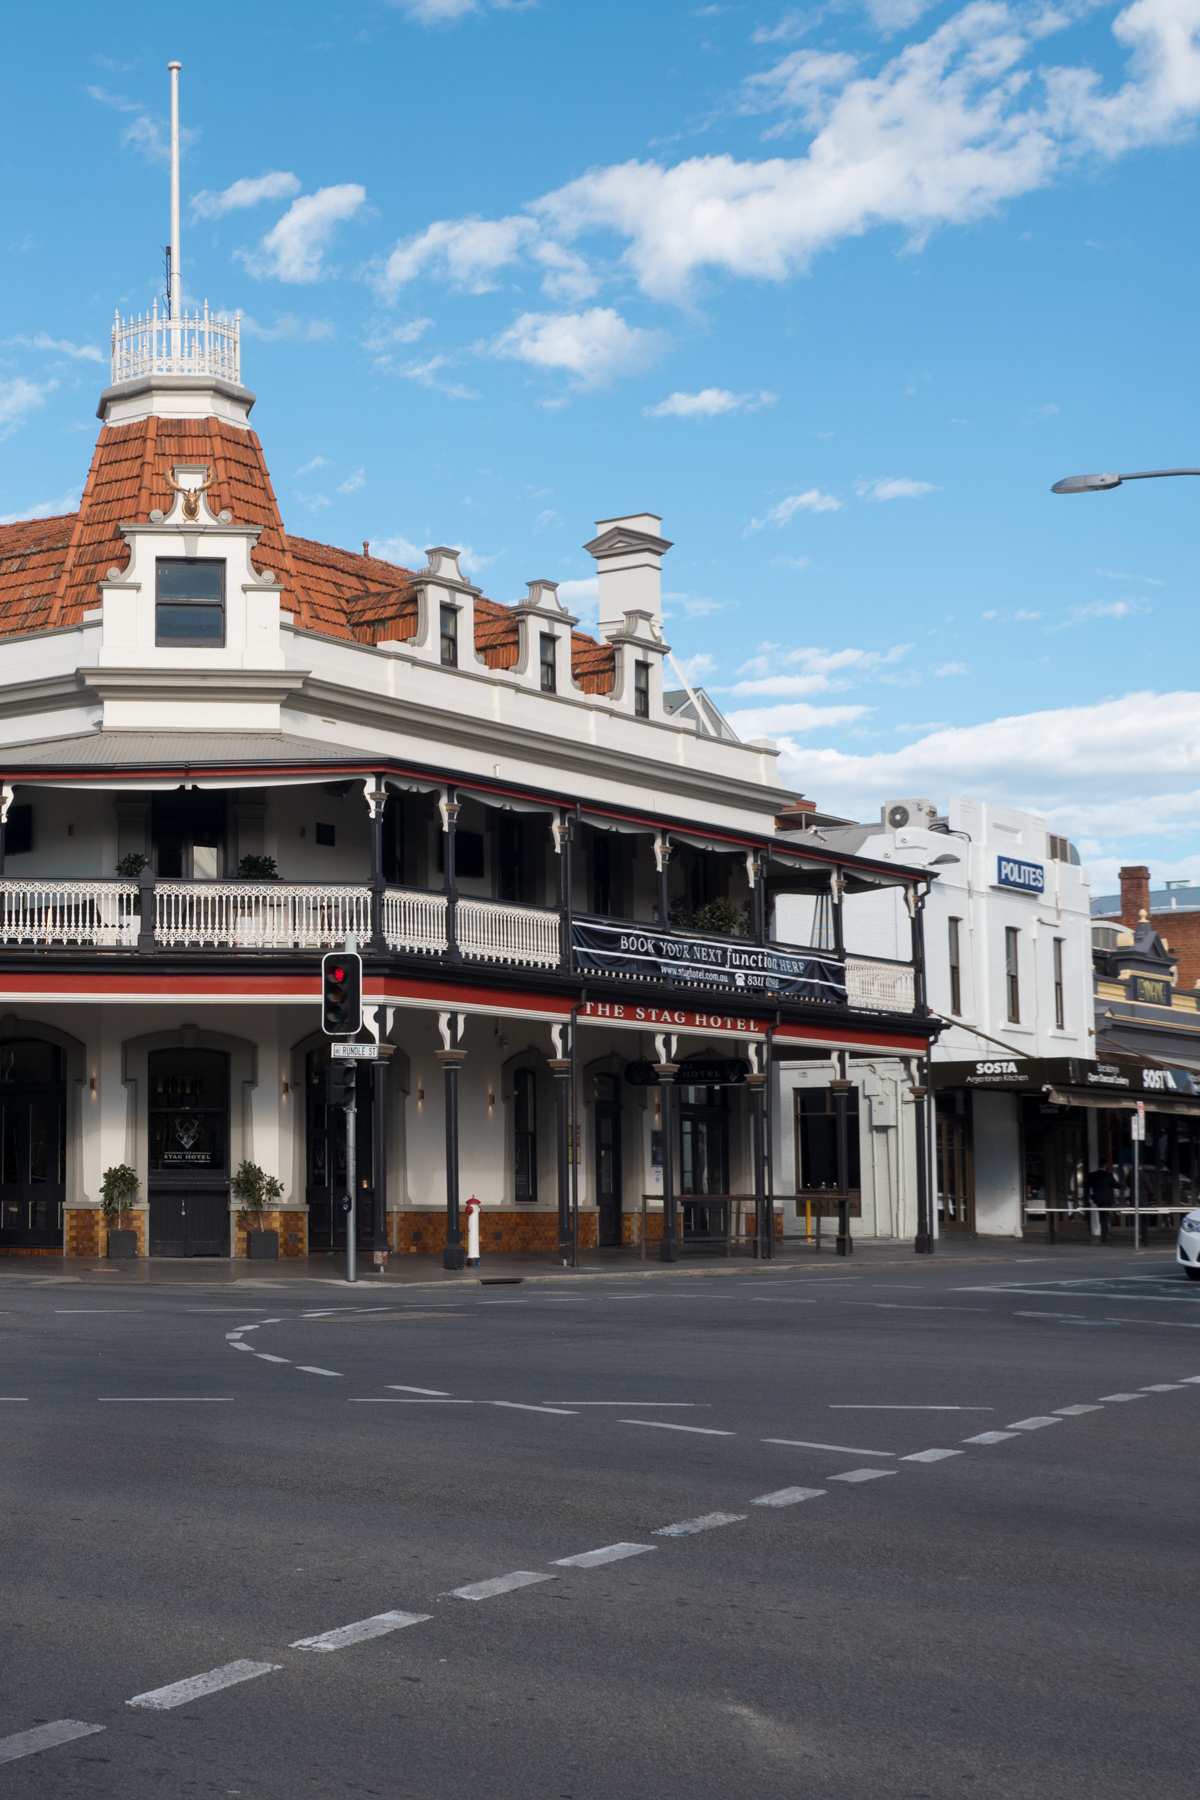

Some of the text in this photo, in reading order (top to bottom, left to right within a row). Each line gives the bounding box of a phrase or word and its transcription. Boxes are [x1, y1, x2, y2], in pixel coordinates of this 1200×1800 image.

[1001, 861, 1043, 887] POLITES
[620, 936, 804, 975] BOOK YOUR NEXT function HERE
[585, 1001, 759, 1032] THE STAG HOTEL
[342, 1046, 366, 1056] RUNDLE
[976, 1061, 1018, 1074] SOSTA
[1003, 1074, 1029, 1082] Kitchen
[1142, 1069, 1177, 1089] SOSTA
